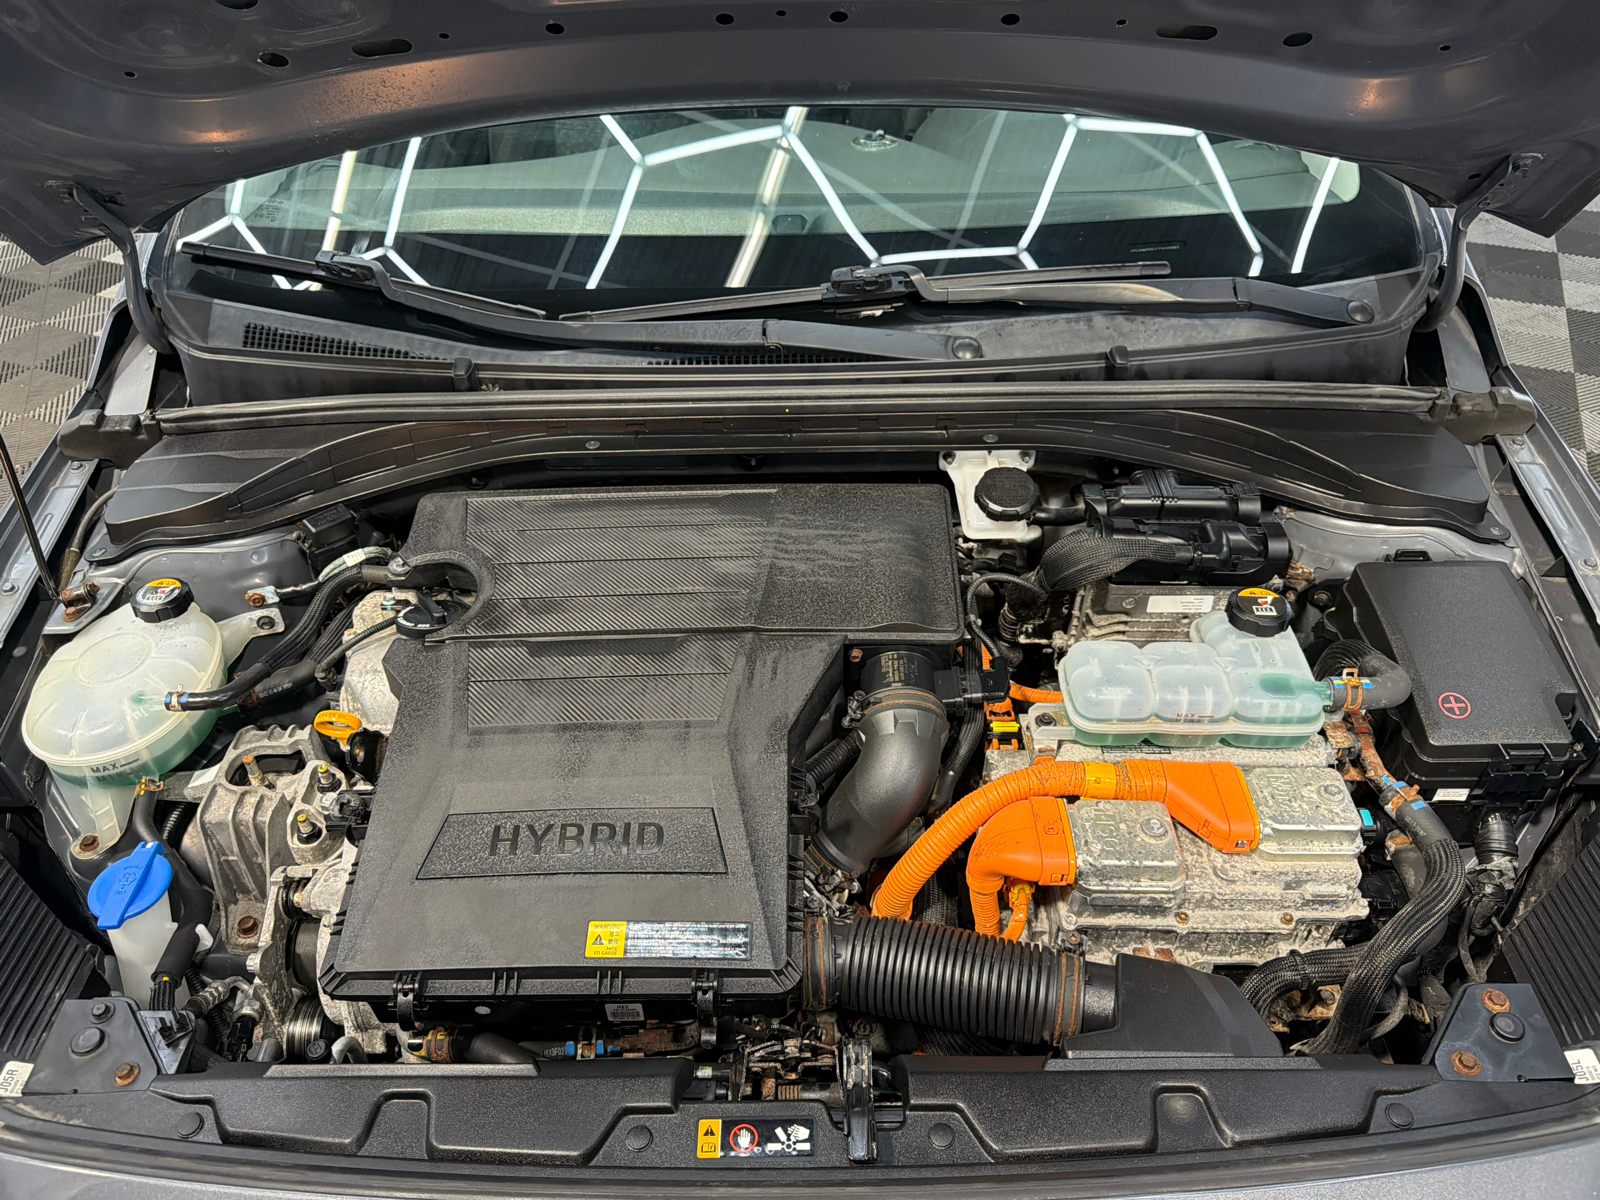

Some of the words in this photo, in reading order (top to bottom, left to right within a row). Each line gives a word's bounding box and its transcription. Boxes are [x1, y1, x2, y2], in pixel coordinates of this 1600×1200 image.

[91, 762, 119, 774] MAX
[489, 822, 665, 857] HYBRID
[0, 1069, 20, 1093] J05R
[1570, 1059, 1590, 1082] J05L
